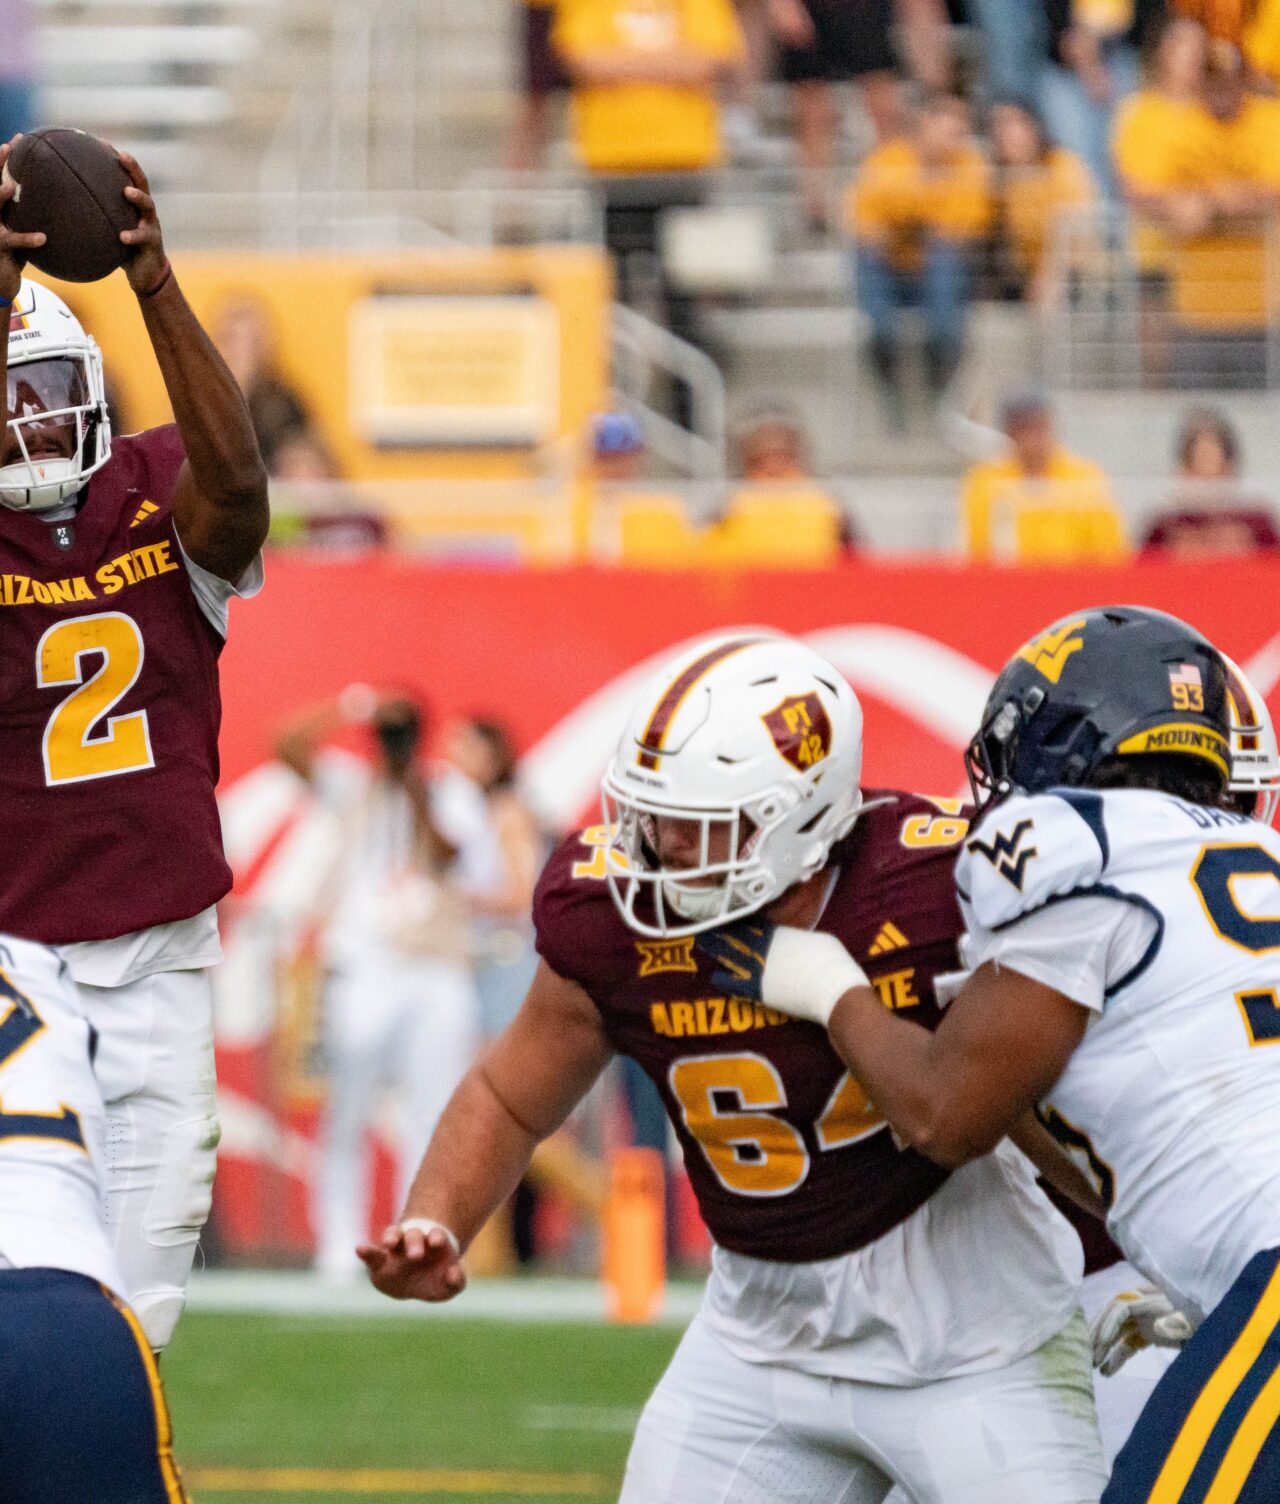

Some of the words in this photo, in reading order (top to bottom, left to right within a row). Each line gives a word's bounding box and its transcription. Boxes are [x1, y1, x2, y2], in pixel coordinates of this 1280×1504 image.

[96, 540, 179, 595] STATE
[35, 611, 156, 787] 2
[1170, 683, 1204, 712] 93
[782, 701, 812, 735] PT
[798, 734, 825, 765] 42
[650, 999, 792, 1038] ARIZON
